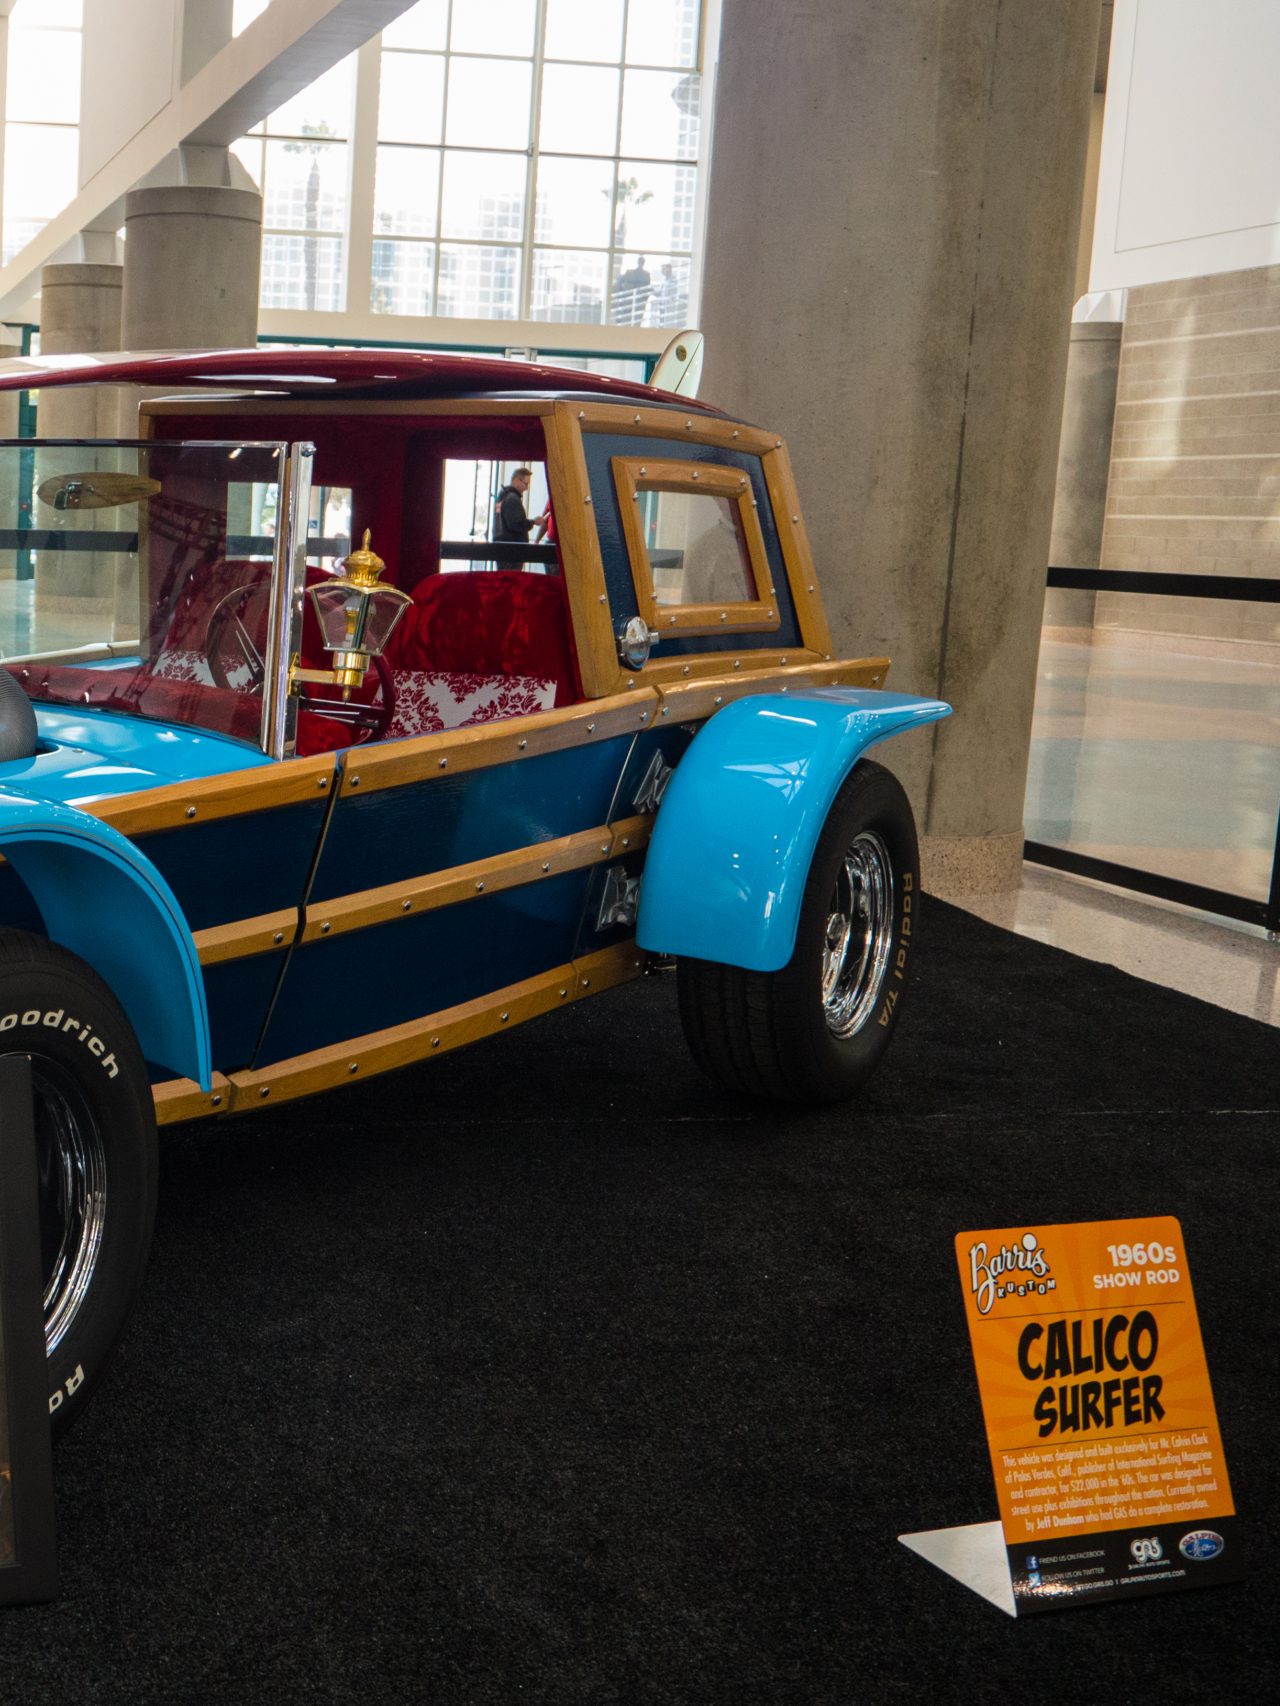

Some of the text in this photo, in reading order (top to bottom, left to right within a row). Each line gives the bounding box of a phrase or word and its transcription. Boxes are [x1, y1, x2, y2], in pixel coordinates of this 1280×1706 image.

[878, 872, 913, 1027] Radial T/A
[1107, 1241, 1177, 1267] 1960s
[969, 1233, 1050, 1315] Barris
[997, 1279, 1056, 1298] KUSTOM
[1093, 1269, 1180, 1289] SHOW ROD
[1018, 1310, 1159, 1381] CALICO
[1033, 1374, 1166, 1438] SURFER
[1003, 1455, 1016, 1468] This
[1017, 1452, 1040, 1466] vehicle
[1041, 1453, 1054, 1462] was
[1055, 1446, 1084, 1463] designed
[1084, 1444, 1098, 1457] and
[1098, 1443, 1113, 1455] built
[1114, 1438, 1148, 1453] exclusively
[1149, 1436, 1159, 1450] for
[1172, 1435, 1191, 1447] Calvin
[1191, 1432, 1208, 1445] Clark
[1005, 1470, 1012, 1484] of
[1013, 1470, 1032, 1483] Palos
[1078, 1461, 1106, 1477] publisher
[1108, 1458, 1115, 1471] of
[1116, 1454, 1157, 1470] International
[1157, 1451, 1182, 1466] Surfing
[1182, 1450, 1212, 1464] Magazine
[1011, 1486, 1024, 1500] and
[1059, 1480, 1069, 1493] for
[1100, 1478, 1107, 1489] in
[1108, 1474, 1119, 1487] the
[1136, 1471, 1148, 1483] The
[1149, 1473, 1159, 1482] car
[1160, 1472, 1173, 1480] was
[1174, 1464, 1202, 1481] designed
[1202, 1463, 1213, 1476] for
[1011, 1504, 1030, 1516] street
[1031, 1504, 1043, 1514] use
[1044, 1499, 1058, 1515] plus
[1059, 1496, 1094, 1510] exhibitions
[1094, 1491, 1131, 1507] throughout
[1131, 1487, 1142, 1500] the
[1166, 1480, 1195, 1497] Currently
[1196, 1478, 1218, 1493] owned
[1025, 1518, 1034, 1533] by
[1037, 1515, 1051, 1530] Jeff
[1052, 1512, 1085, 1527] Dunham
[1085, 1510, 1099, 1522] who
[1100, 1507, 1113, 1520] had
[1113, 1506, 1128, 1519] GAS
[1128, 1505, 1137, 1518] do
[1144, 1500, 1173, 1516] complete
[1039, 1556, 1058, 1564] FRIEND
[1076, 1550, 1105, 1560] FACEBOOK
[1041, 1572, 1064, 1581] FOLLOW
[1083, 1567, 1105, 1576] TWITTER
